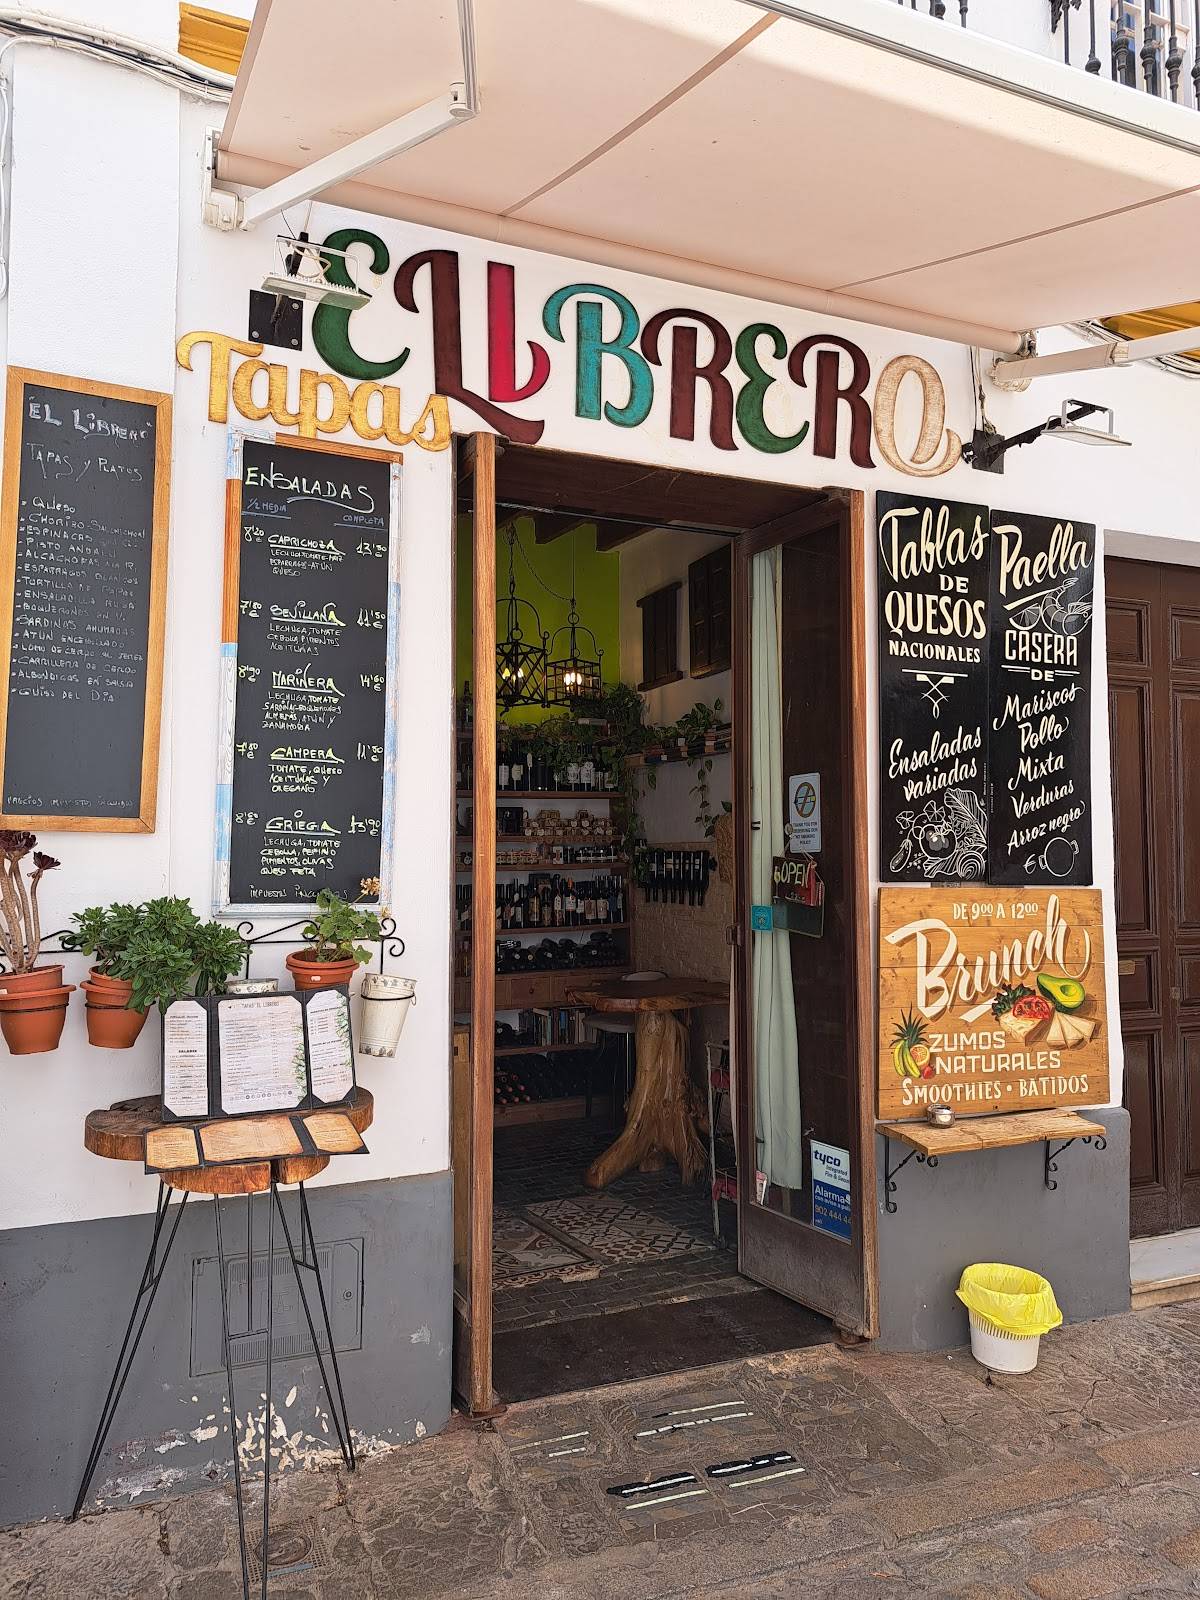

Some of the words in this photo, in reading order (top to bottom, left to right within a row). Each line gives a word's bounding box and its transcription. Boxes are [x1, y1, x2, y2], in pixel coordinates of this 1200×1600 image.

[176, 331, 451, 451] Tapas
[245, 462, 374, 513] ENSALADAS
[262, 502, 287, 513] MEDIA
[343, 515, 384, 527] COMPLETA
[879, 505, 989, 583] Tablas
[992, 521, 1093, 598] Paella
[939, 574, 969, 593] DE
[885, 590, 987, 639] QUESOS
[889, 639, 981, 664] NACIONALES
[1005, 629, 1078, 666] CASERA
[1031, 669, 1055, 682] DE
[62, 690, 80, 700] DEL
[993, 683, 1087, 731] Mariscos
[1018, 714, 1069, 753] Pollo
[270, 746, 345, 764] CAMPERA
[889, 725, 982, 779] Ensaladas
[903, 757, 978, 801] variadas
[1008, 751, 1065, 790] Mixta
[1010, 779, 1074, 818] Verduras
[265, 809, 341, 834] GRIEGA
[1007, 822, 1047, 856] Arroz
[1049, 800, 1086, 833] negro
[781, 861, 811, 888] OPEN
[953, 903, 968, 920] DE
[996, 903, 1006, 919] A
[884, 893, 1091, 1019] Brunch
[928, 1031, 1006, 1053] ZUMOS
[935, 1051, 1061, 1075] NATURALES
[902, 1077, 1001, 1106] SMOOTHIES
[1019, 1074, 1089, 1098] BATIDOS
[814, 1149, 841, 1167] tyco
